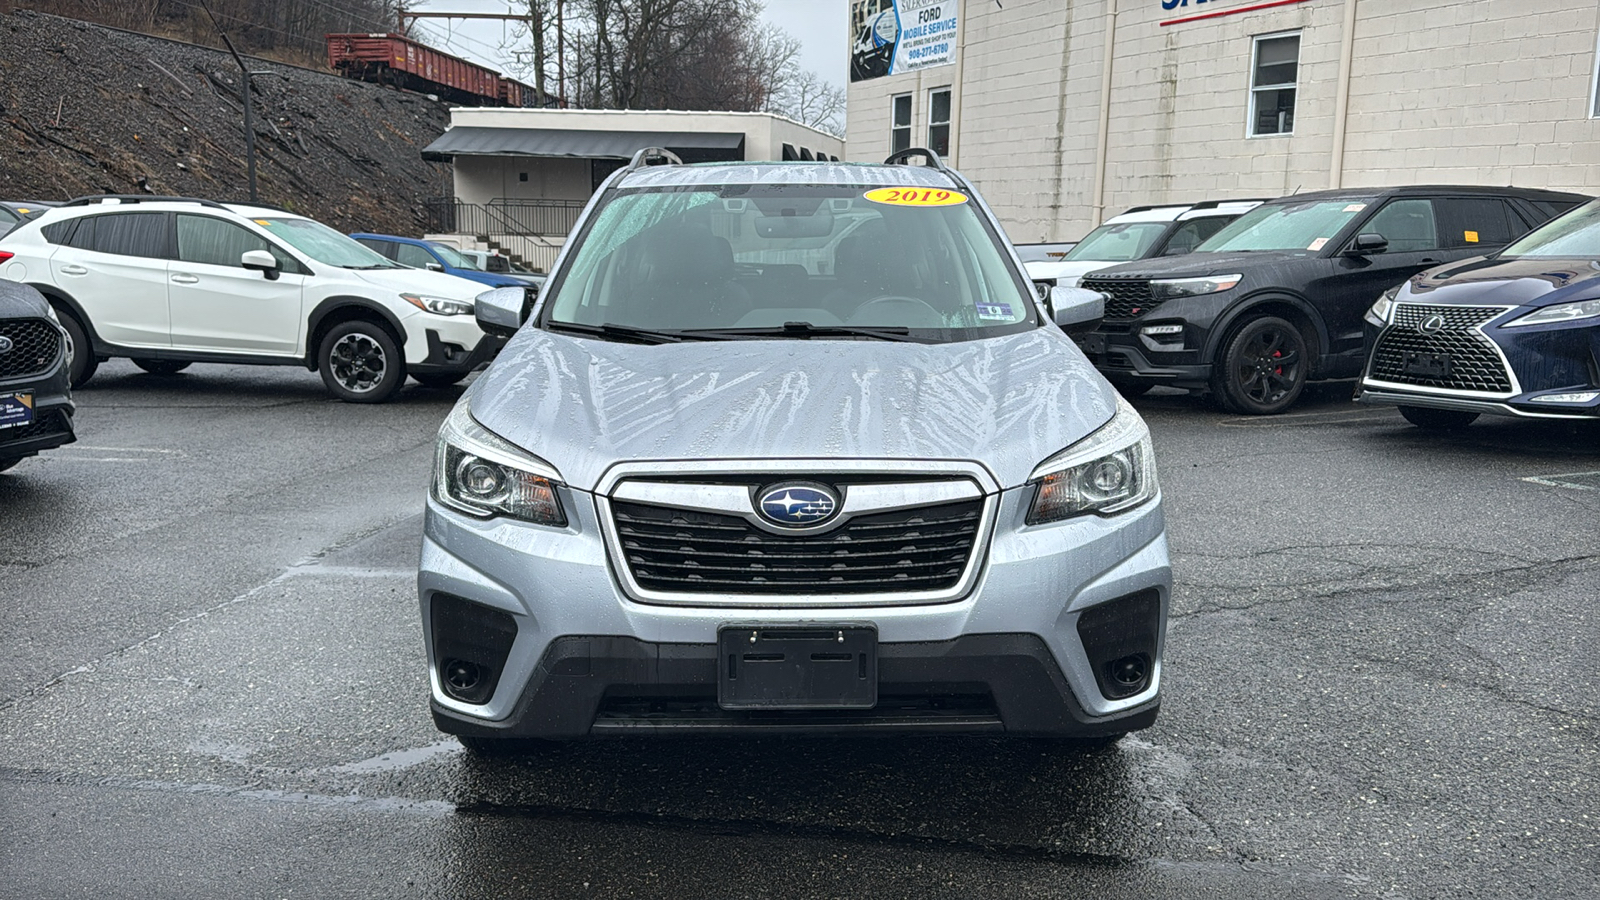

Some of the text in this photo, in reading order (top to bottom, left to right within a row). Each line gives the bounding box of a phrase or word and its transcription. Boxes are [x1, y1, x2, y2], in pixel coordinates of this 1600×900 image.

[918, 6, 941, 24] FORD
[903, 25, 927, 40] MOBILE
[928, 17, 957, 34] SERVICE
[908, 43, 949, 60] 908-277-6780
[884, 190, 951, 202] 2019
